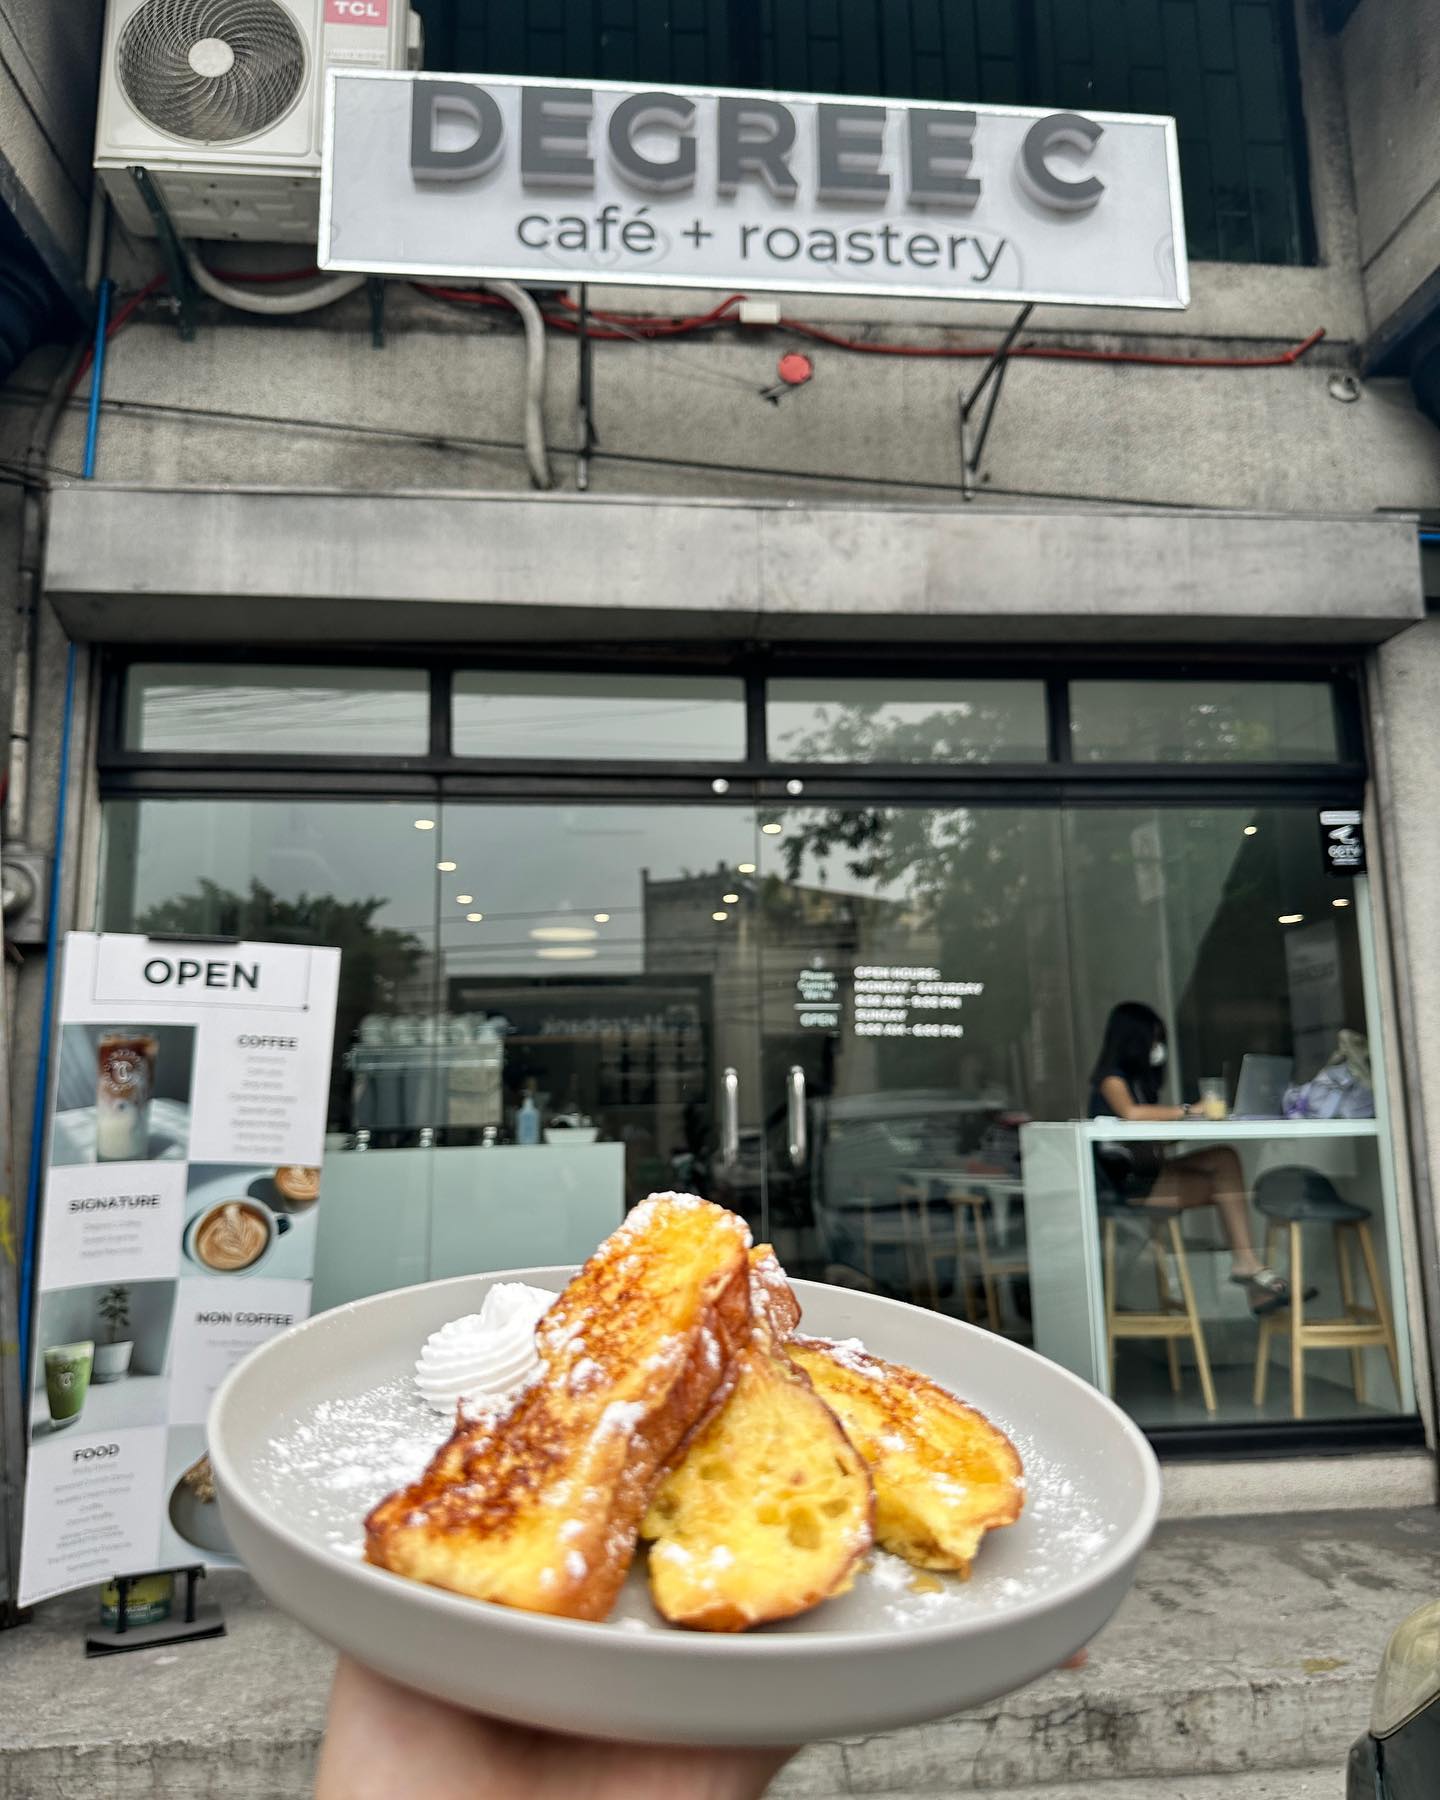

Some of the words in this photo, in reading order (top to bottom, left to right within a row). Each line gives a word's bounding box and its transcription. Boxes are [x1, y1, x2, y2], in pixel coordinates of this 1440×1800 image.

[333, 1, 380, 17] TCL
[410, 80, 983, 207] DEGREE
[1018, 112, 1105, 211] C
[516, 205, 657, 253] café
[681, 218, 713, 250] +
[740, 222, 1007, 282] roastery
[143, 958, 260, 990] OPEN
[854, 966, 889, 979] OPEN
[854, 980, 910, 994] MONDAY
[917, 981, 984, 996] SATURDAY
[800, 1012, 837, 1027] OPEN
[854, 1008, 908, 1022] SUNDAY
[237, 1034, 298, 1050] COFFEE
[67, 1194, 161, 1213] SIGNATURE
[196, 1311, 232, 1325] NON
[234, 1312, 294, 1326] COFFEE
[72, 1443, 120, 1463] FOOD
